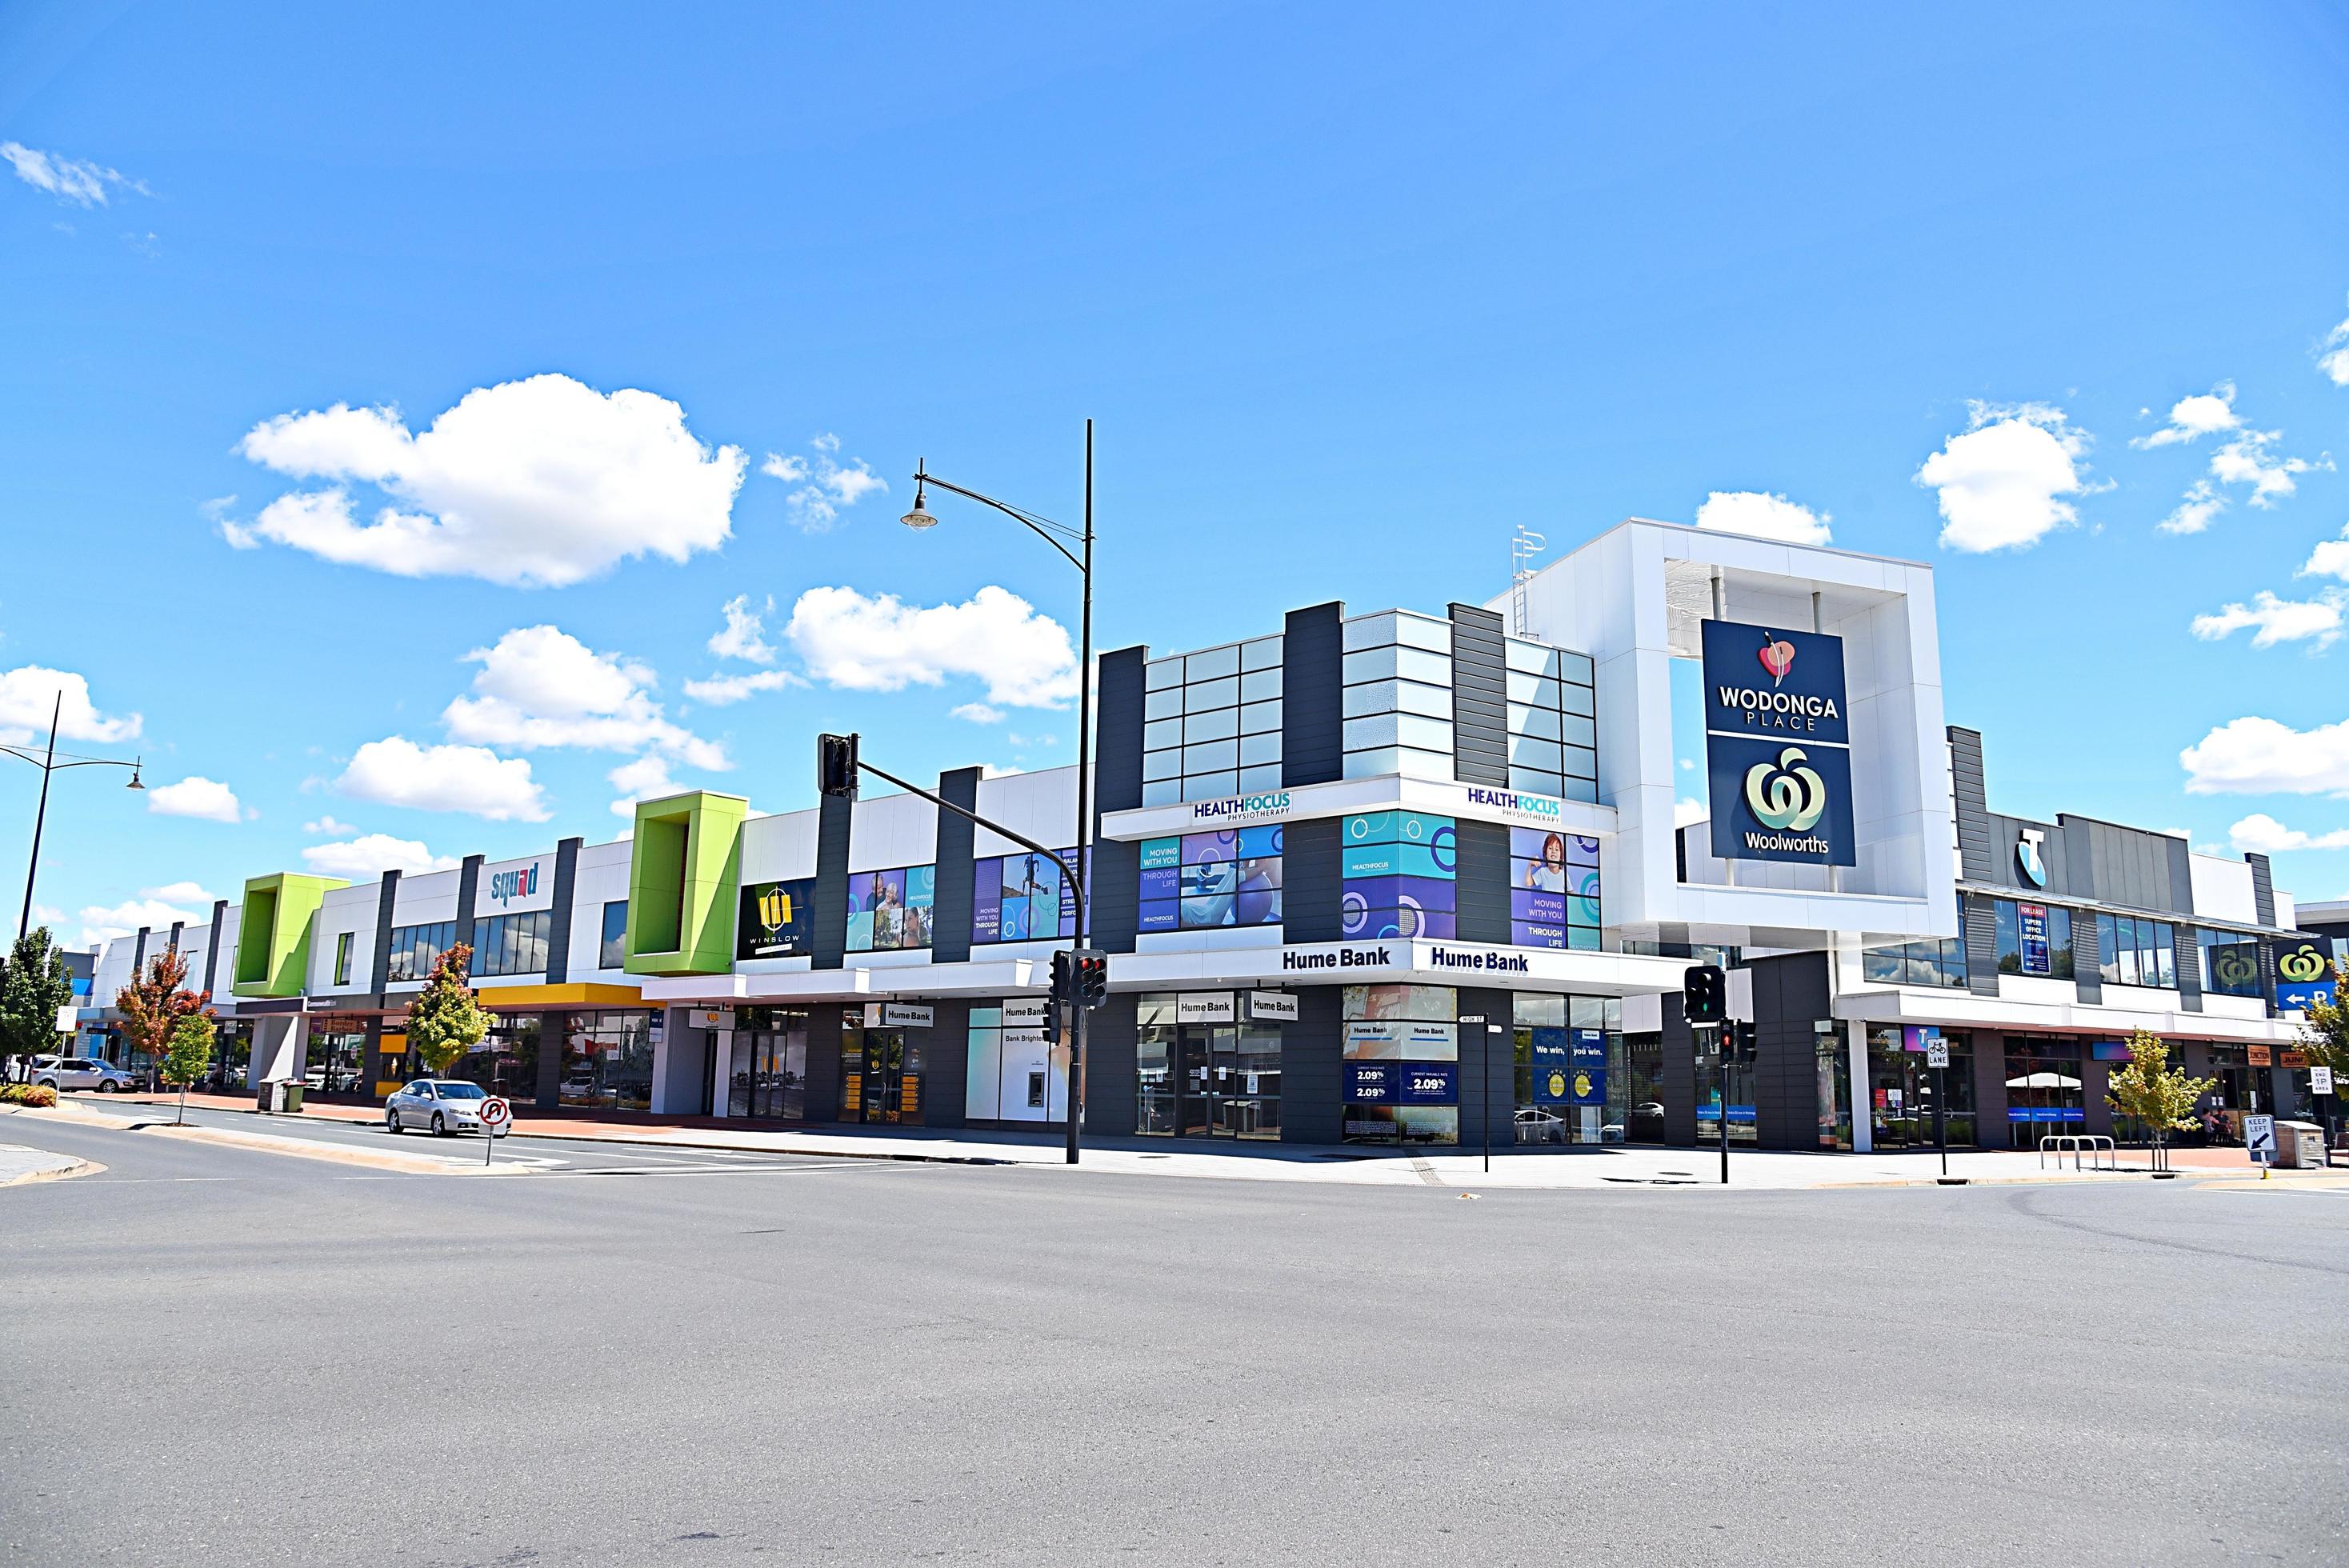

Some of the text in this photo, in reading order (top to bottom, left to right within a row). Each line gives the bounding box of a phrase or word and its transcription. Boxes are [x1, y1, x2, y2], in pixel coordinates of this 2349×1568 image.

[1719, 686, 1839, 718] WODONGA
[1747, 711, 1815, 731] PLACE
[1194, 793, 1291, 818] HEALTHFOCUS
[1468, 787, 1559, 816] HEALTHFOCUS
[1227, 807, 1291, 821] PHYSIOTHERAPY
[1502, 809, 1560, 824] PHYSIOTHERAPY
[1745, 831, 1830, 854] Woolworths
[1150, 848, 1178, 858] MOVING
[1352, 862, 1389, 870] HEALTHFOCUS
[1142, 870, 1178, 879] THROUGH
[1534, 898, 1563, 910] MOVING
[1528, 909, 1563, 919] WITH YOU
[2031, 907, 2044, 915] LEASE
[2024, 918, 2042, 926] SUPERB
[1528, 926, 1563, 938] THROUGH
[2025, 926, 2042, 934] OFFICE
[750, 935, 799, 944] WINSLOW
[2022, 933, 2046, 942] LOCATION
[1548, 939, 1563, 948] LIFE
[1283, 947, 1391, 970] Hume Bank
[1432, 947, 1529, 972] Hume Bank
[1181, 1002, 1231, 1012] Hume Bank
[1254, 999, 1295, 1012] Hume Bank
[888, 1010, 930, 1021] Hume Bank
[1006, 1008, 1046, 1016] Hume Bank
[1536, 1046, 1603, 1057] We win, you win.
[2249, 1050, 2270, 1059] JUNCTION
[1357, 1071, 1384, 1080] 2.09%
[1414, 1078, 1446, 1090] 2.09%
[1356, 1088, 1386, 1097] 2.09%
